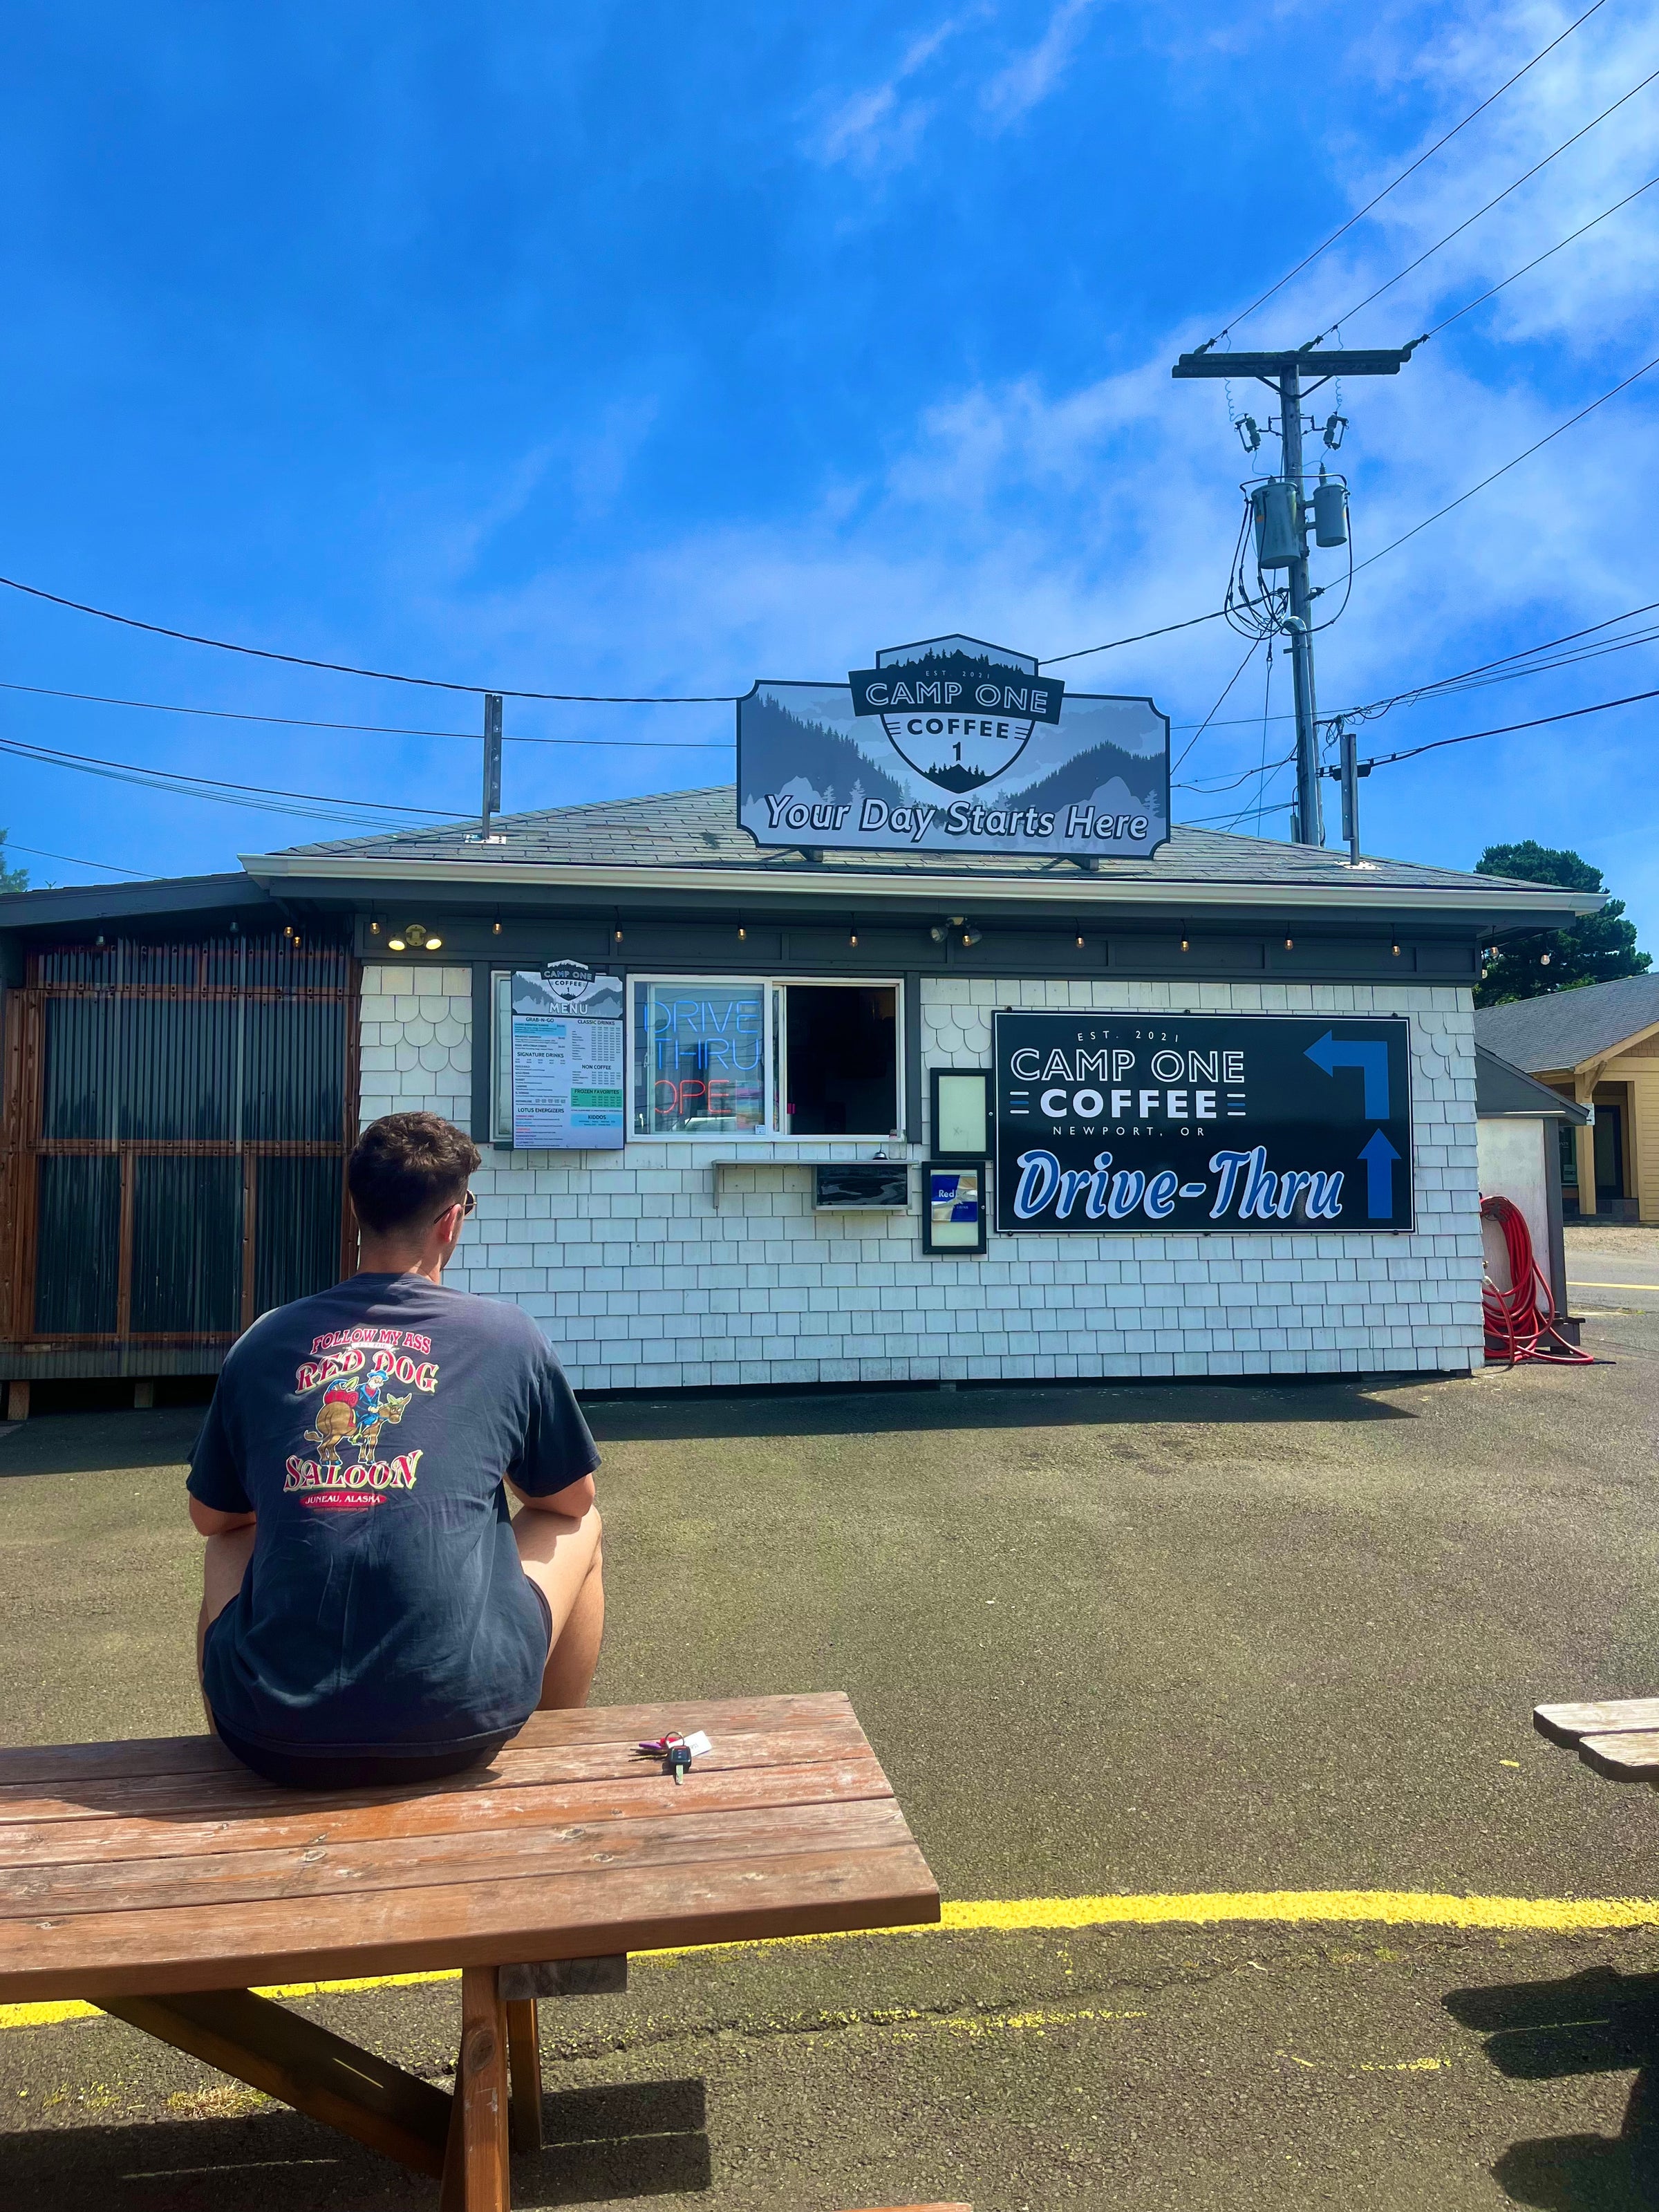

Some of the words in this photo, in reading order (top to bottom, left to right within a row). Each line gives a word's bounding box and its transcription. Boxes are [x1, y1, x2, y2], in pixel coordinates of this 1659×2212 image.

[962, 671, 990, 679] 2021
[865, 680, 963, 706] CAMP
[975, 683, 1049, 715] ONE
[906, 718, 1010, 740] COFFEE
[952, 741, 962, 762] 1
[764, 794, 851, 830] Your
[859, 797, 936, 843] Day
[944, 800, 1056, 838] Starts
[1064, 805, 1148, 841] Here
[572, 971, 592, 980] ONE
[548, 1002, 588, 1015] MENU
[643, 1000, 760, 1034] DRIVE
[1077, 1030, 1119, 1042] EST.
[1136, 1030, 1179, 1042] 2021
[654, 1038, 760, 1071] THRU
[1010, 1048, 1135, 1082] CAMP
[1151, 1049, 1245, 1083] ONE
[1040, 1089, 1217, 1118] COFFEE
[1052, 1125, 1163, 1137] NEWPORT,
[1181, 1127, 1205, 1136] OR
[939, 1189, 955, 1198] Red
[1013, 1145, 1344, 1219] Drive-Thru
[310, 1328, 376, 1355] FOLLOW
[379, 1329, 403, 1346] MY
[403, 1331, 432, 1355] ASS
[294, 1349, 366, 1394] RED
[372, 1350, 440, 1394] DOG
[283, 1449, 424, 1493] SALOON
[305, 1495, 342, 1504] JUNEAU,
[344, 1495, 381, 1503] ALASKA
